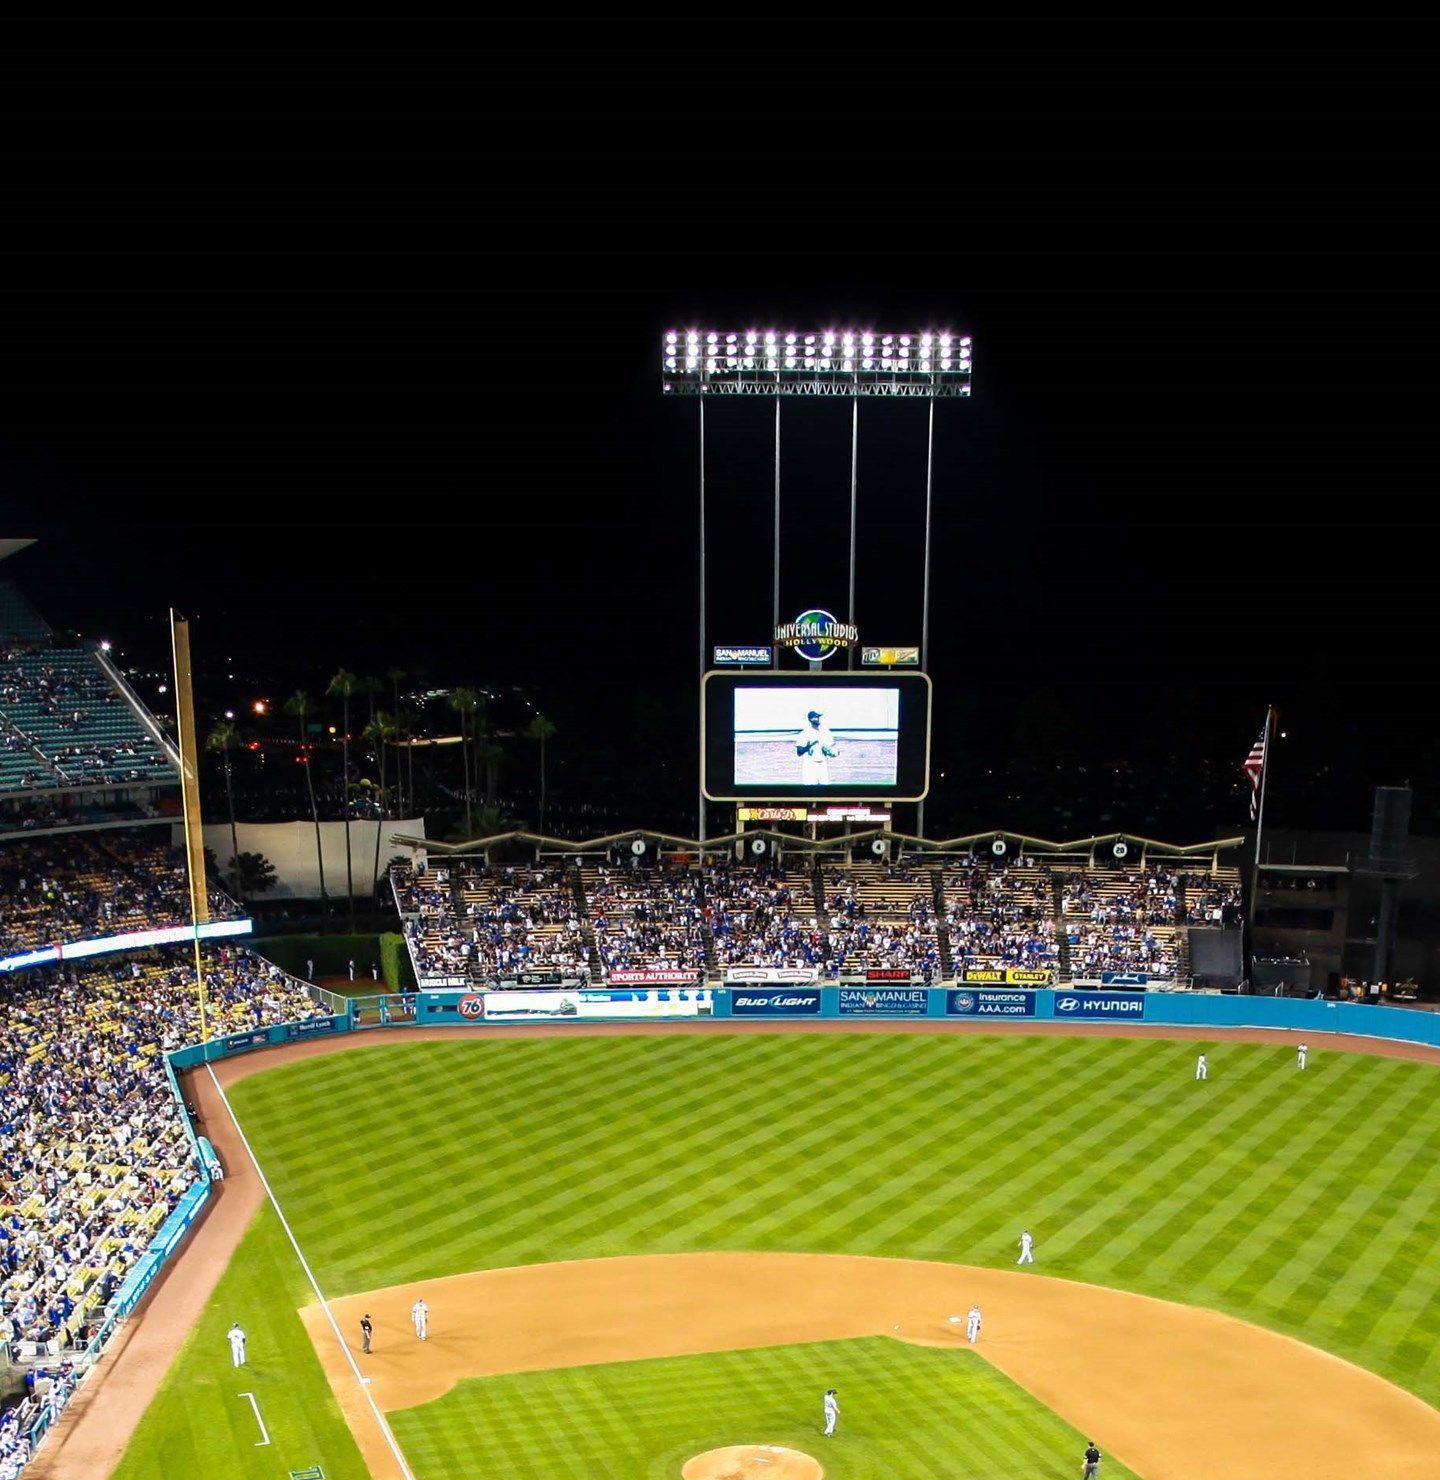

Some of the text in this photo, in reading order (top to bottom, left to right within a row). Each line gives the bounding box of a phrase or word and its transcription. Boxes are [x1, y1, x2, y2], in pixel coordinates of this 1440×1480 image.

[774, 622, 859, 641] UNIVERSAL STUDIOS
[785, 638, 848, 647] HOLLYWOOD
[716, 649, 770, 658] SAN MANUEL
[611, 971, 698, 982] SPORTS AUTHORITY
[867, 970, 909, 979] SHARP
[1014, 972, 1043, 980] STANLEY
[840, 991, 927, 1002] SAN MANUEL
[978, 993, 1026, 1002] Insurance
[462, 998, 482, 1015] 76
[735, 998, 817, 1006] BUD LIGHT
[1083, 1001, 1143, 1011] HYUNDAI
[978, 1005, 1026, 1013] AAA.com
